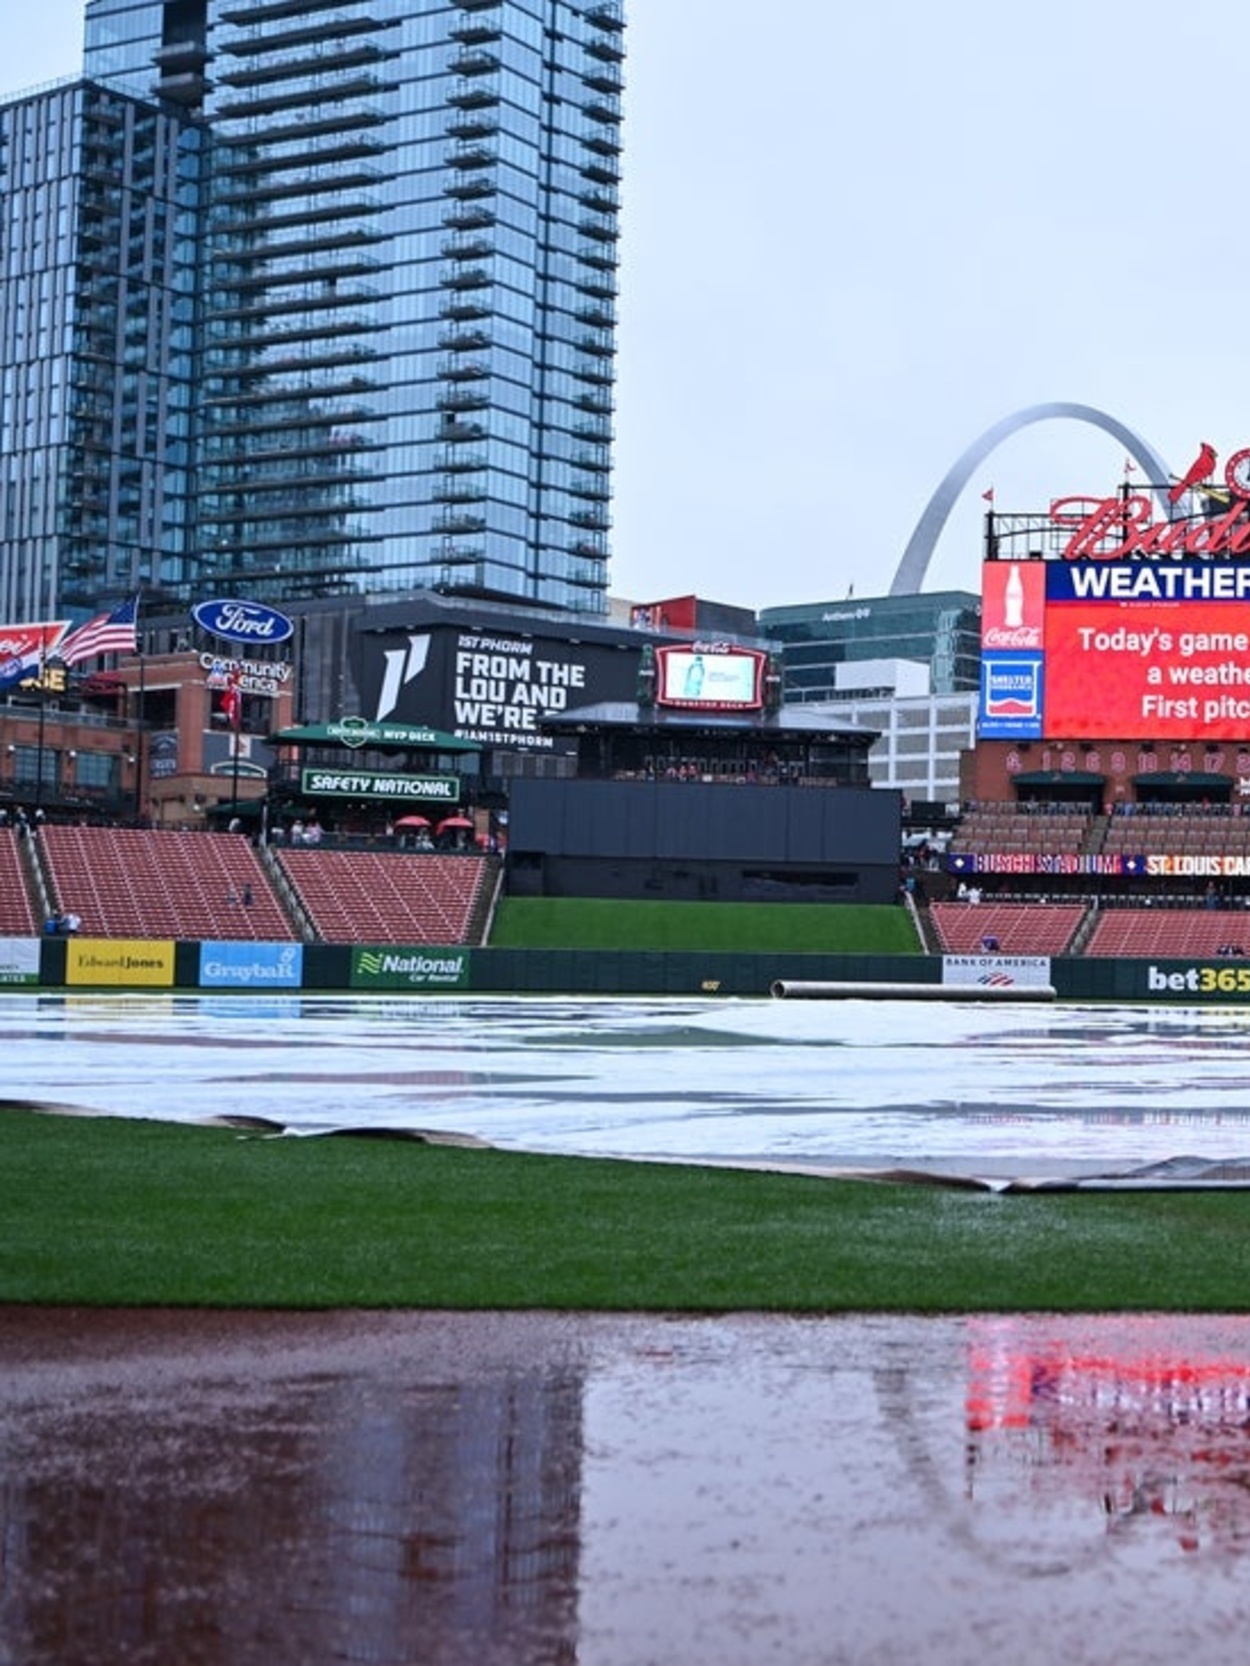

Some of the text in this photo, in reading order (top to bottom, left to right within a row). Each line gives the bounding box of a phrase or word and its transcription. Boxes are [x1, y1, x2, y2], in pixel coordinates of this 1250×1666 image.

[215, 603, 276, 636] Ford
[984, 626, 1040, 646] Coca-Cola
[1077, 627, 1173, 657] Today's
[1179, 633, 1249, 657] game
[456, 651, 585, 687] FROM THE
[1147, 666, 1162, 684] a
[456, 676, 566, 709] LOU AND
[454, 700, 537, 730] WE'RE
[1142, 695, 1199, 719] First
[1203, 752, 1225, 774] 17
[311, 775, 452, 796] SAFETY NATIONAL
[1174, 856, 1220, 876] LOUIS
[382, 954, 464, 974] National
[946, 959, 1047, 967] BANK OF AMERICA
